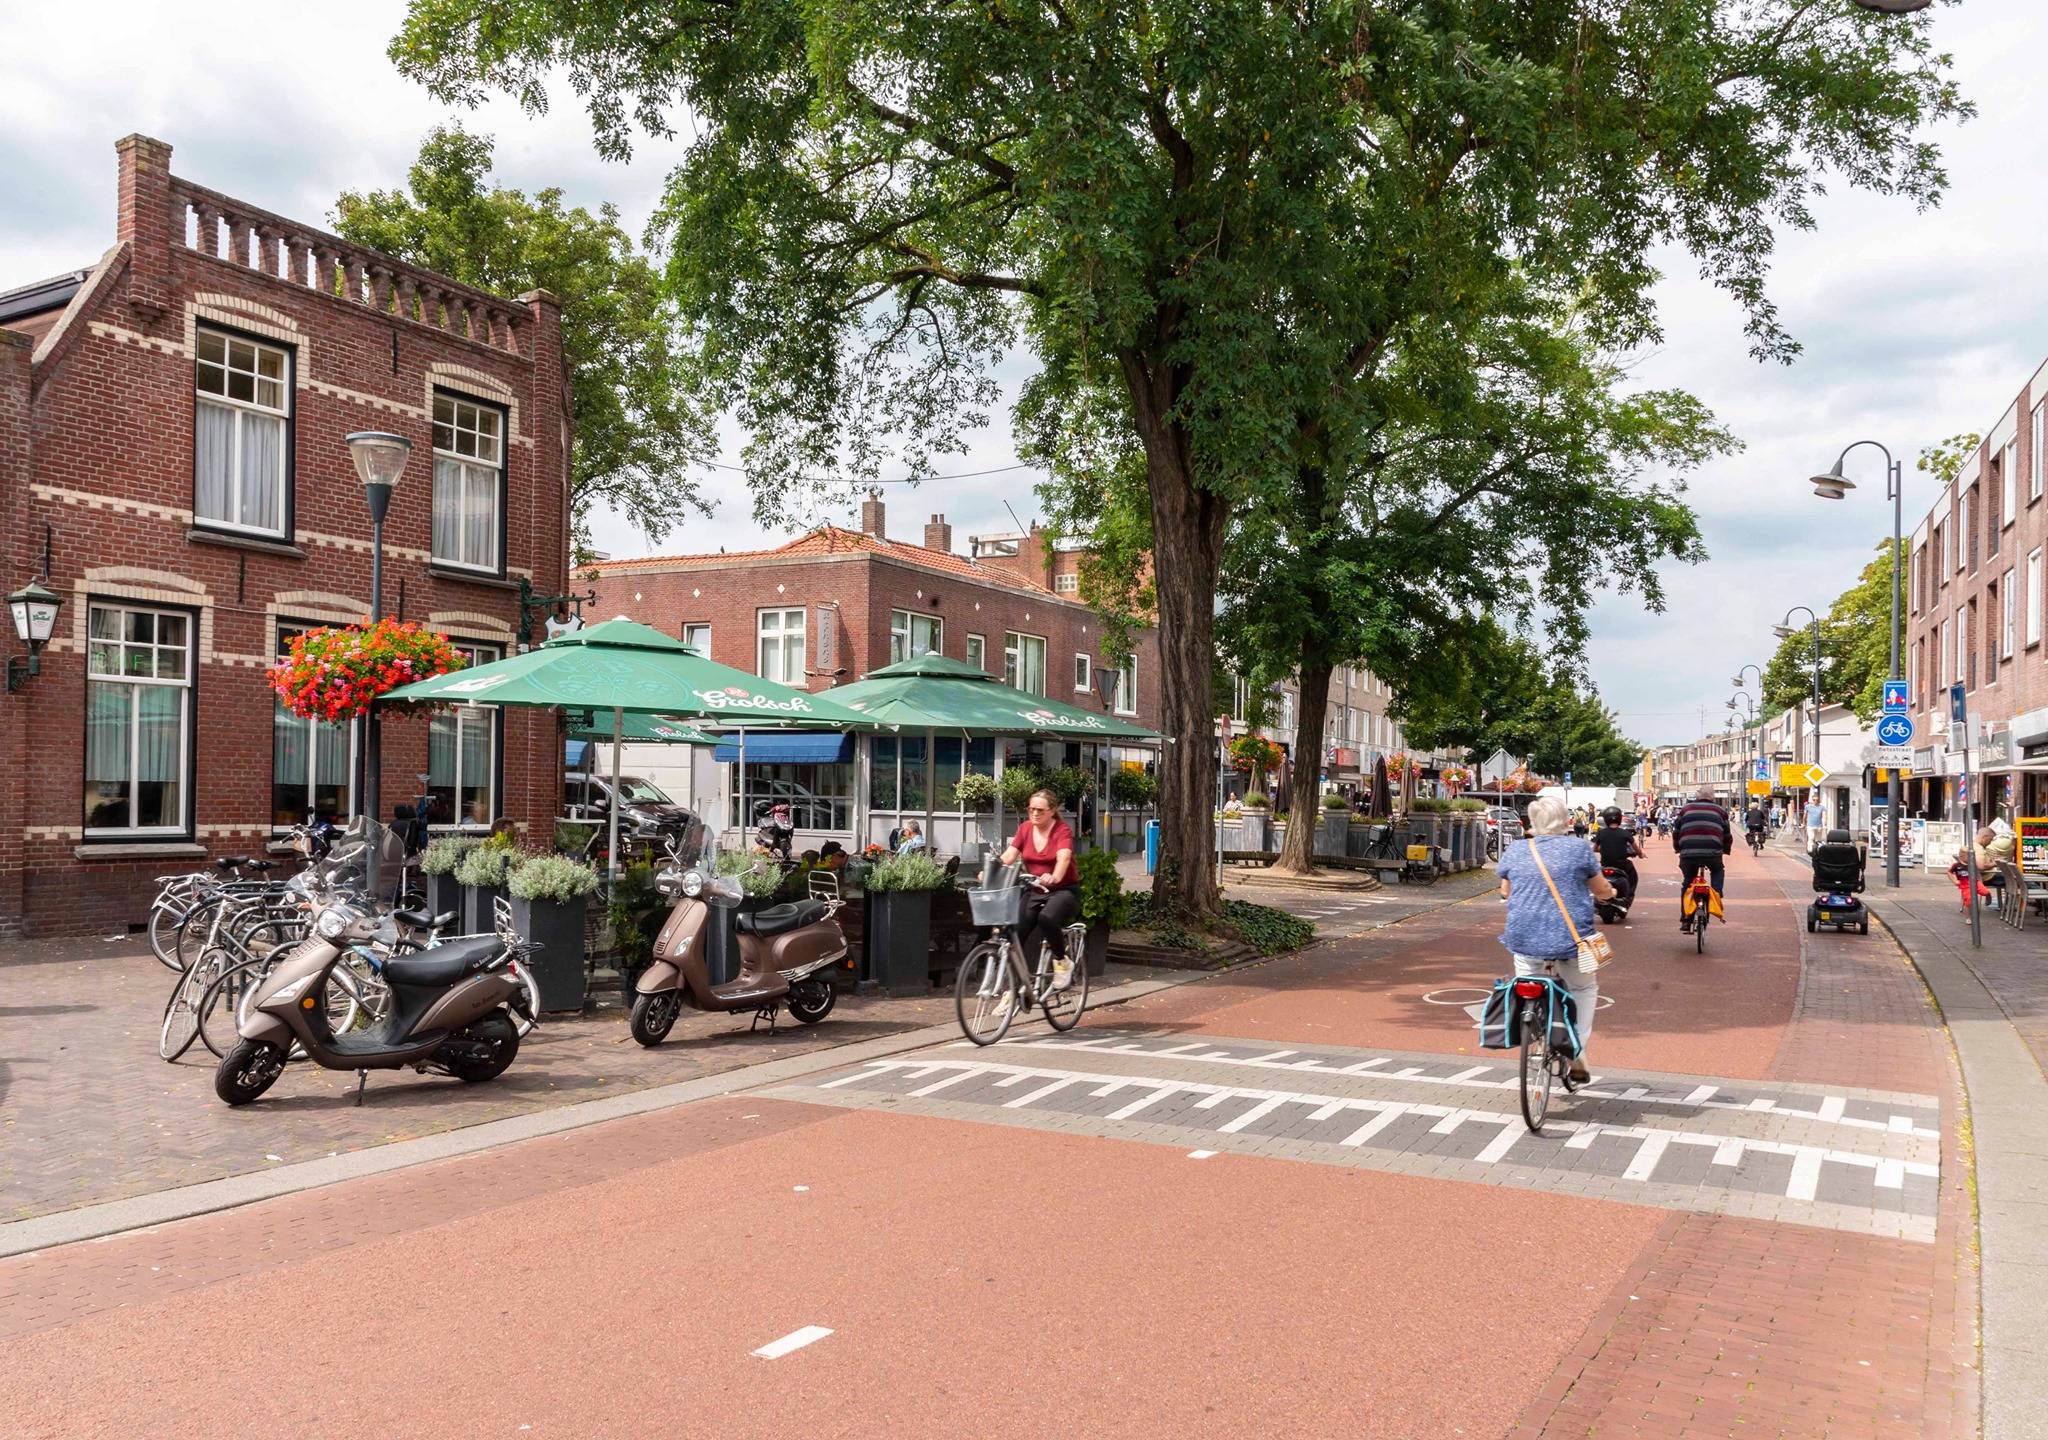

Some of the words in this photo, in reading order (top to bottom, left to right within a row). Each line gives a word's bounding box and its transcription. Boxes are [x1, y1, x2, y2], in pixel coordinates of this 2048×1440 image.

[691, 690, 812, 713] Grolsch
[1016, 710, 1106, 729] Grolsch
[649, 727, 704, 739] Grolsch
